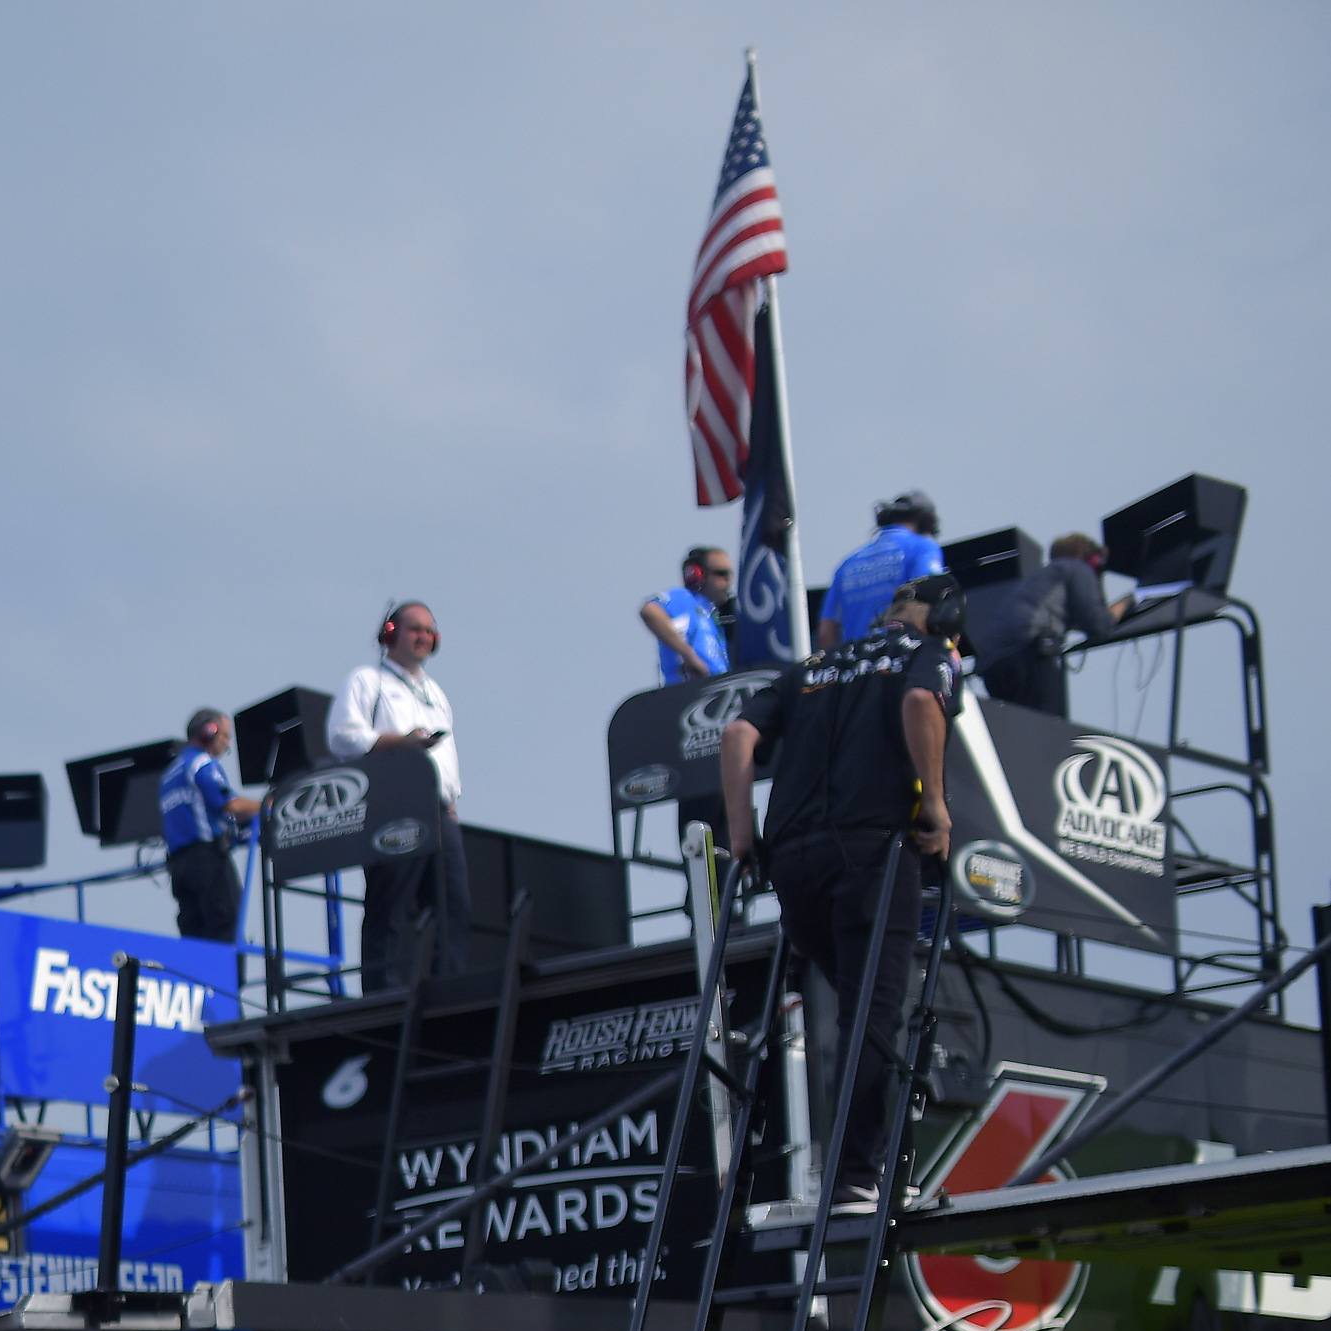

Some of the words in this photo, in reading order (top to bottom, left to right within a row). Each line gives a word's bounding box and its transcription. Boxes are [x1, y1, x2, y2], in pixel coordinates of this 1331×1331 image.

[1060, 805, 1164, 856] ADVOCARE
[544, 1010, 638, 1062] ROUSH
[577, 1043, 674, 1072] RACING
[321, 1053, 372, 1110] 6
[398, 1109, 659, 1190] WYNDHAM
